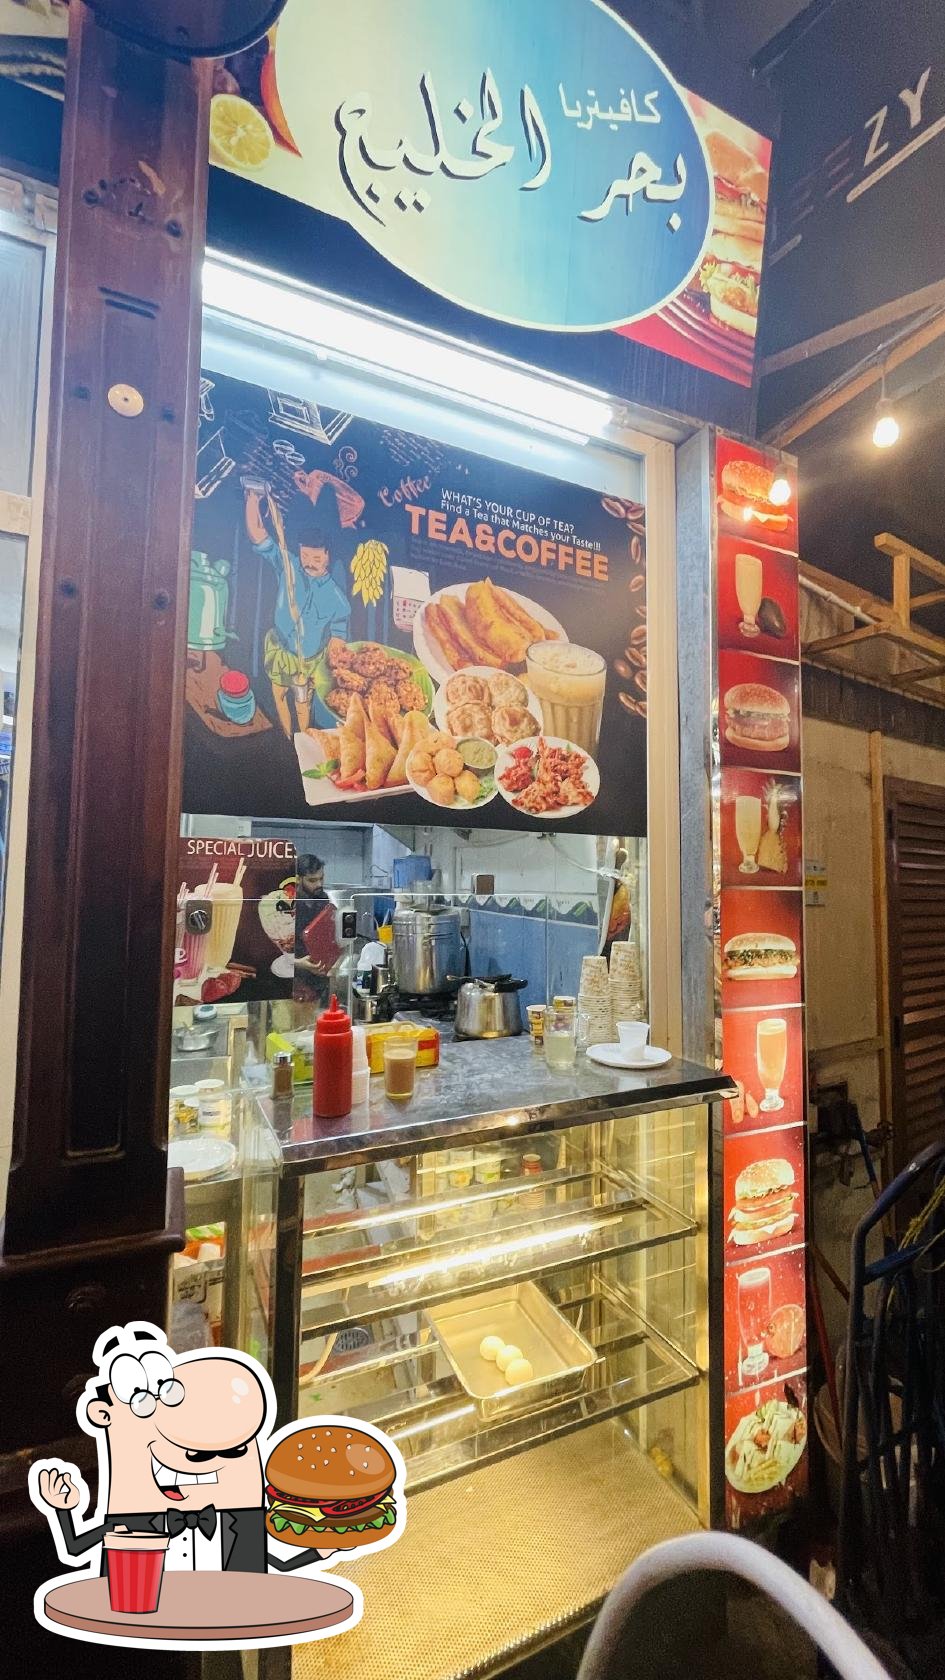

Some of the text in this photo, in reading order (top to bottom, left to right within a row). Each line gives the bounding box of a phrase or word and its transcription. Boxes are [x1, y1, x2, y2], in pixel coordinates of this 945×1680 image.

[558, 82, 662, 130] كافيتريا
[334, 67, 687, 234] بحر الخليج
[377, 475, 431, 508] Coffee
[441, 487, 575, 534] WHAT'S YOUR CUP OF TEA?
[404, 503, 609, 582] TEA&COFFEE
[441, 499, 463, 514] Find
[464, 508, 470, 516] a
[473, 508, 489, 521] Tea
[491, 513, 510, 527] that
[511, 518, 549, 537] Matches
[550, 531, 570, 544] your
[187, 839, 245, 856] SPECIAL
